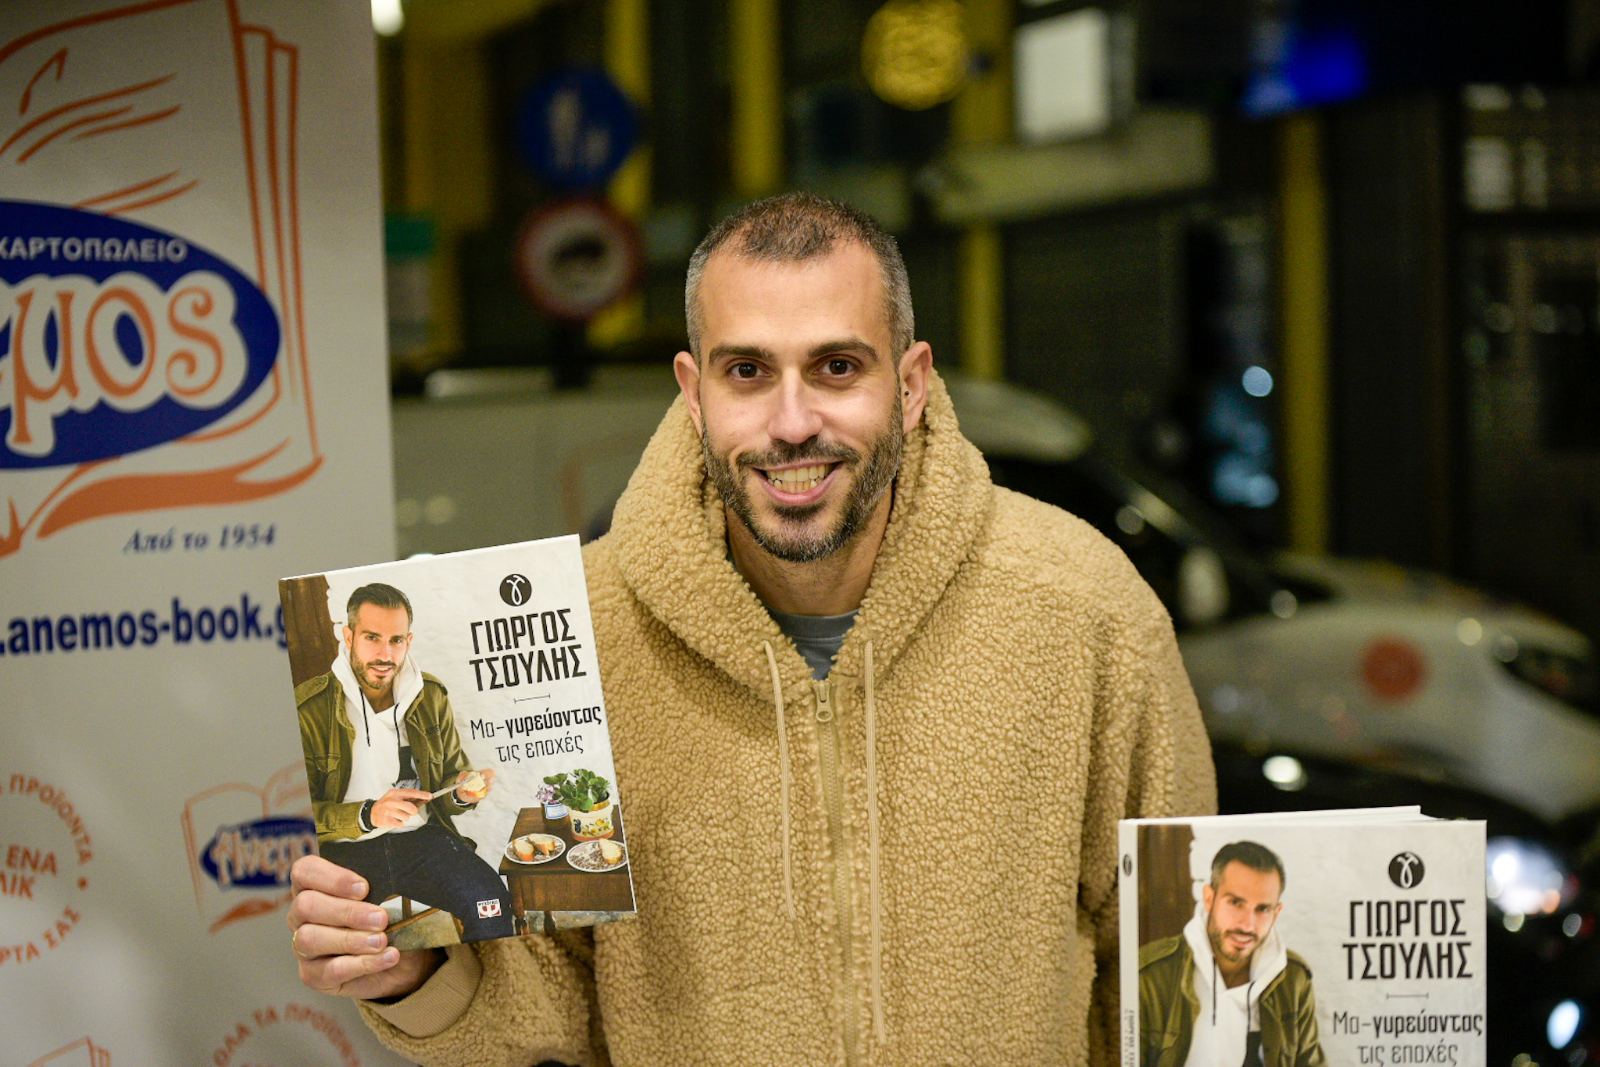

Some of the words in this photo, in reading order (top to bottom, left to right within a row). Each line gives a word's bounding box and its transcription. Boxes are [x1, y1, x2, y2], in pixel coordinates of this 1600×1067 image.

[183, 532, 209, 549] το
[219, 521, 276, 548] 1954
[470, 608, 576, 655] ΓΙΩΡΓΟΣ
[469, 644, 587, 692] ΤΣΟΥΛΗΣ
[470, 706, 603, 741] Μα-γυρεύοντας
[496, 744, 521, 763] τις
[525, 731, 584, 759] εποχές
[6, 845, 57, 876] ΕΝΑ
[1349, 899, 1466, 938] ΓΙΩΡΓΟΣ
[1343, 942, 1473, 981] ΤΣΟΥΛΗΣ
[1333, 1009, 1483, 1039] Μα-γυρεύοντας
[1357, 1045, 1385, 1067] τις
[1391, 1038, 1459, 1067] εποχές
